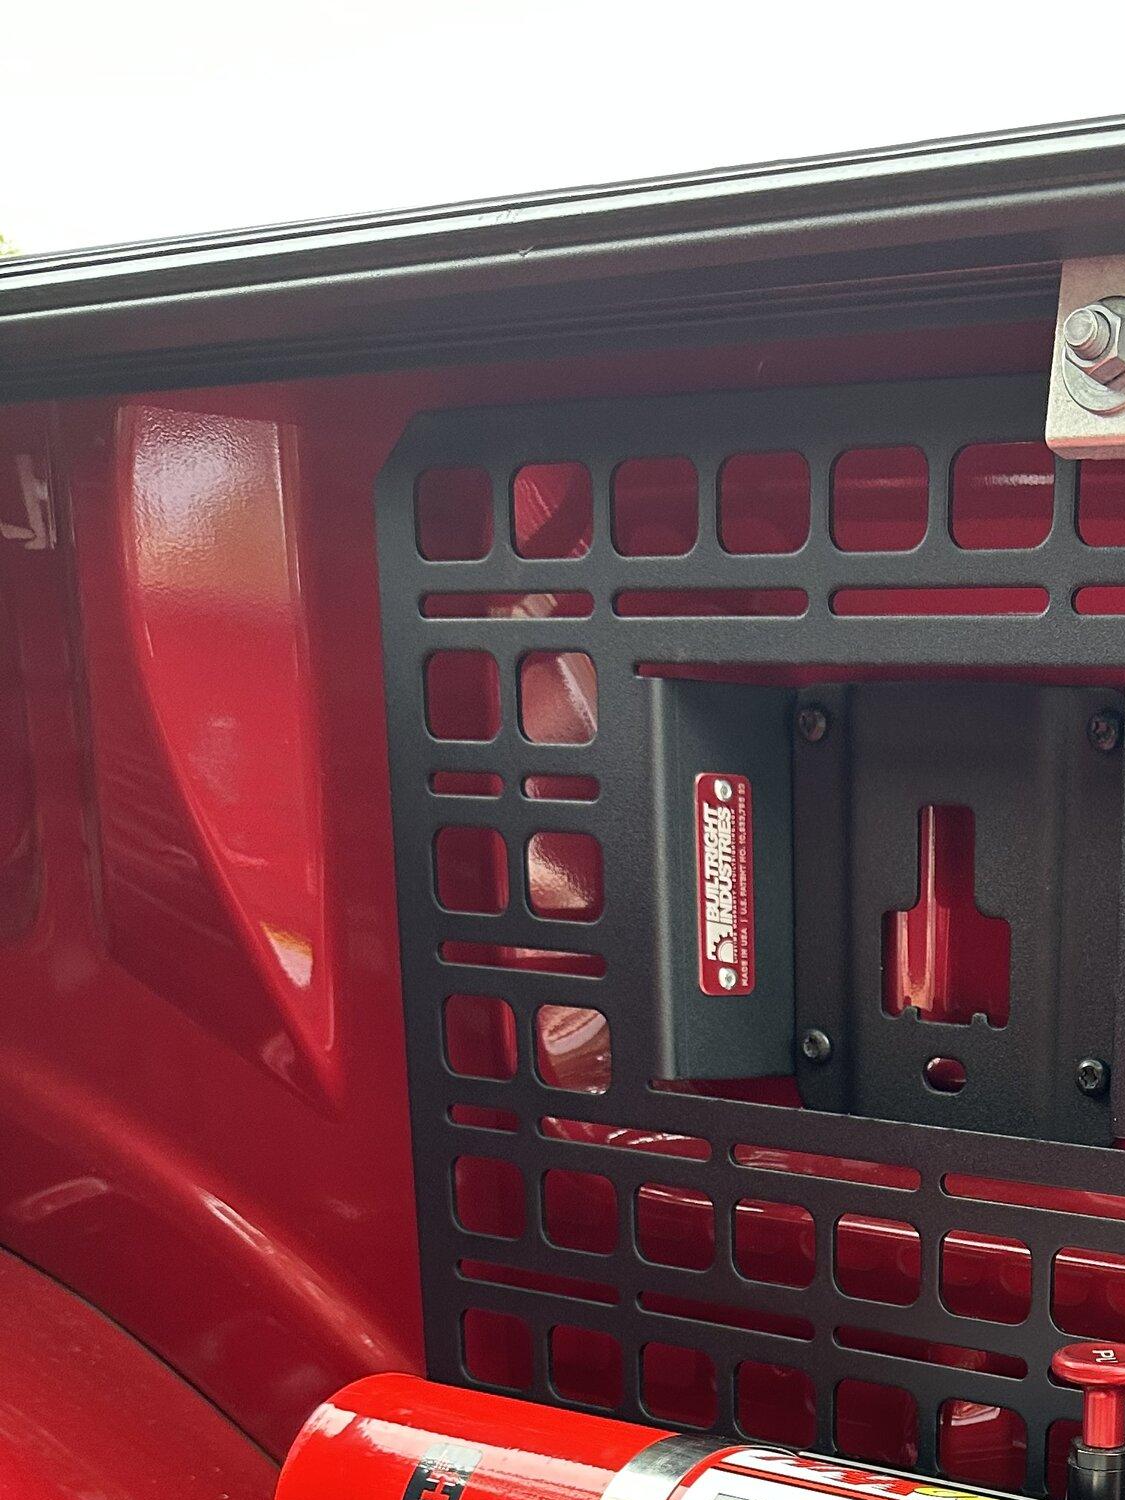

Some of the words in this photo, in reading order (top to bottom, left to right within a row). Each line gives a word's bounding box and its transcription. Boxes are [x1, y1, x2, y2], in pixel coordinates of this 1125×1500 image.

[703, 801, 720, 921] BUILTRIGHT
[717, 807, 733, 923] INDUSTRIES
[740, 927, 748, 946] USA
[741, 947, 748, 959] IN
